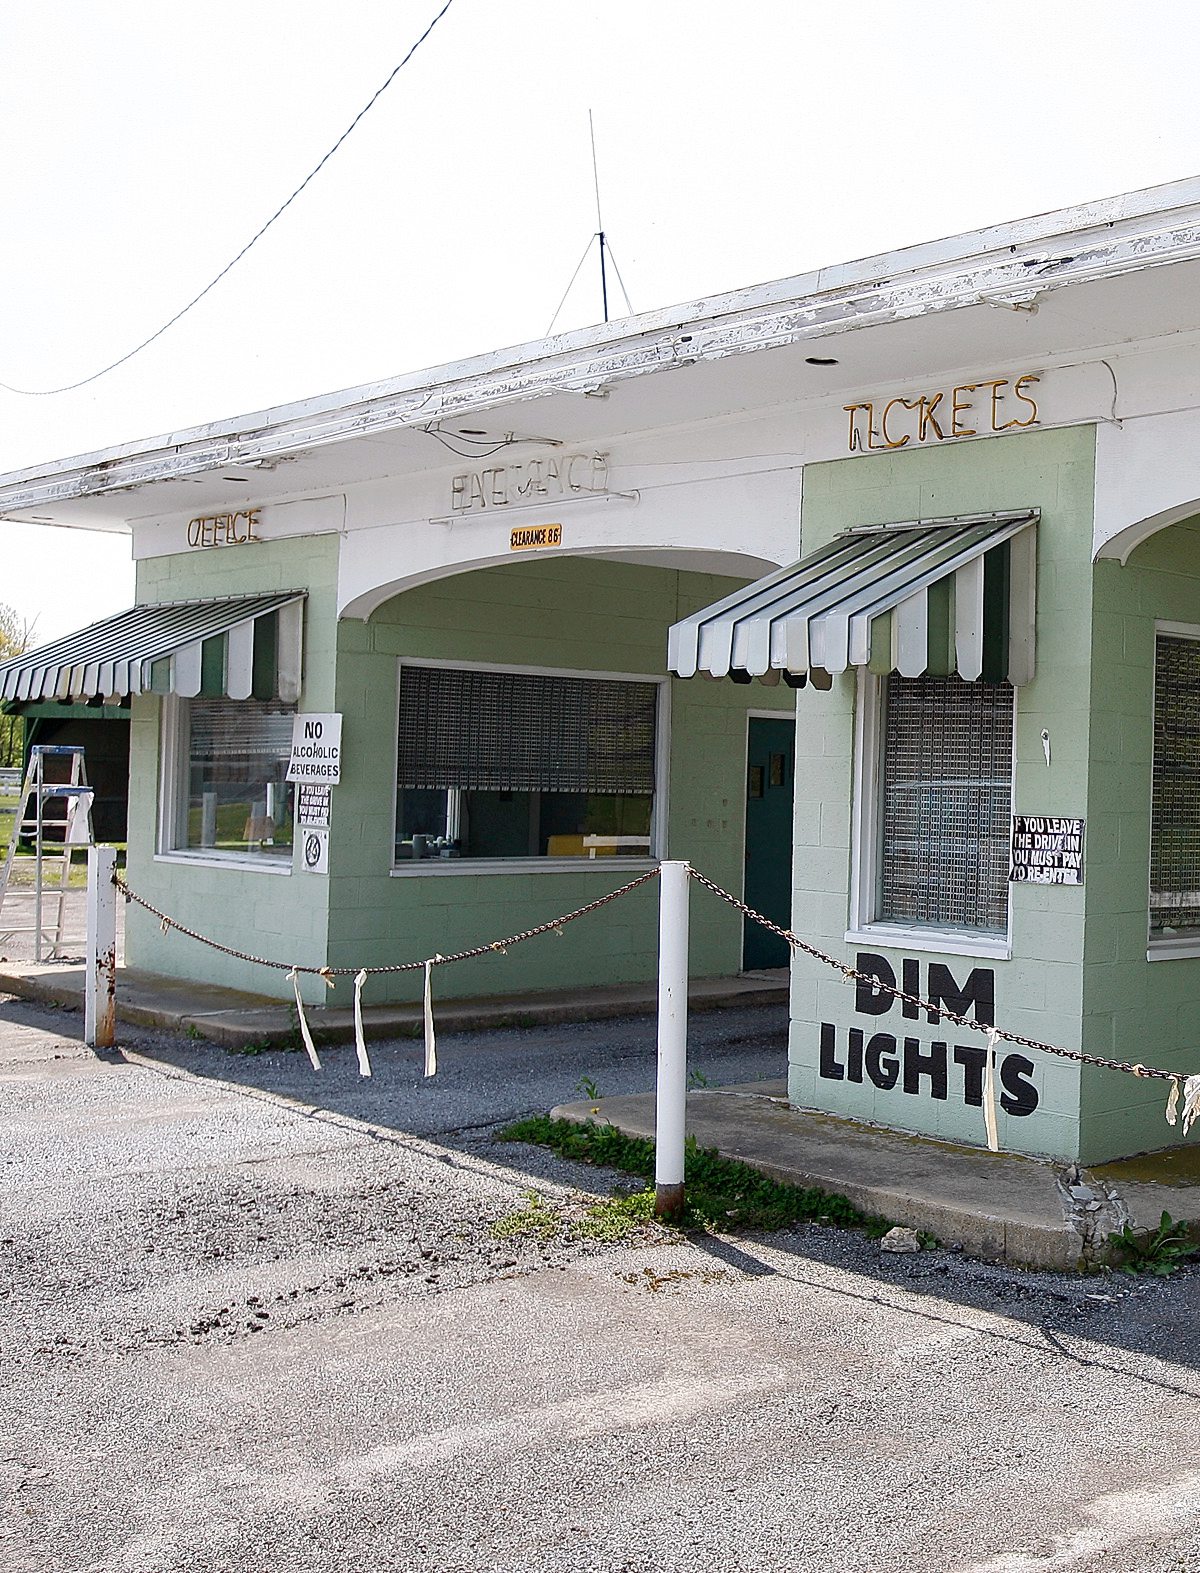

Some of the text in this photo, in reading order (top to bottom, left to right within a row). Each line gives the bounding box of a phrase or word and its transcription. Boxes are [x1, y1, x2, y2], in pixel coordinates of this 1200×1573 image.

[843, 375, 1040, 451] TICKETS
[511, 529, 546, 546] CLEARANCE
[304, 721, 323, 739] NO
[293, 742, 338, 759] ALCOHOLIC
[290, 763, 339, 777] BEVERAGES
[1023, 817, 1045, 833] YOU
[1046, 818, 1080, 835] LEAVE
[1014, 833, 1031, 849] THE
[1034, 834, 1064, 851] DRIVE
[1013, 849, 1082, 869] OU MUST PAY
[855, 952, 995, 1027] DIM
[820, 1022, 1039, 1117] LIGHTS
